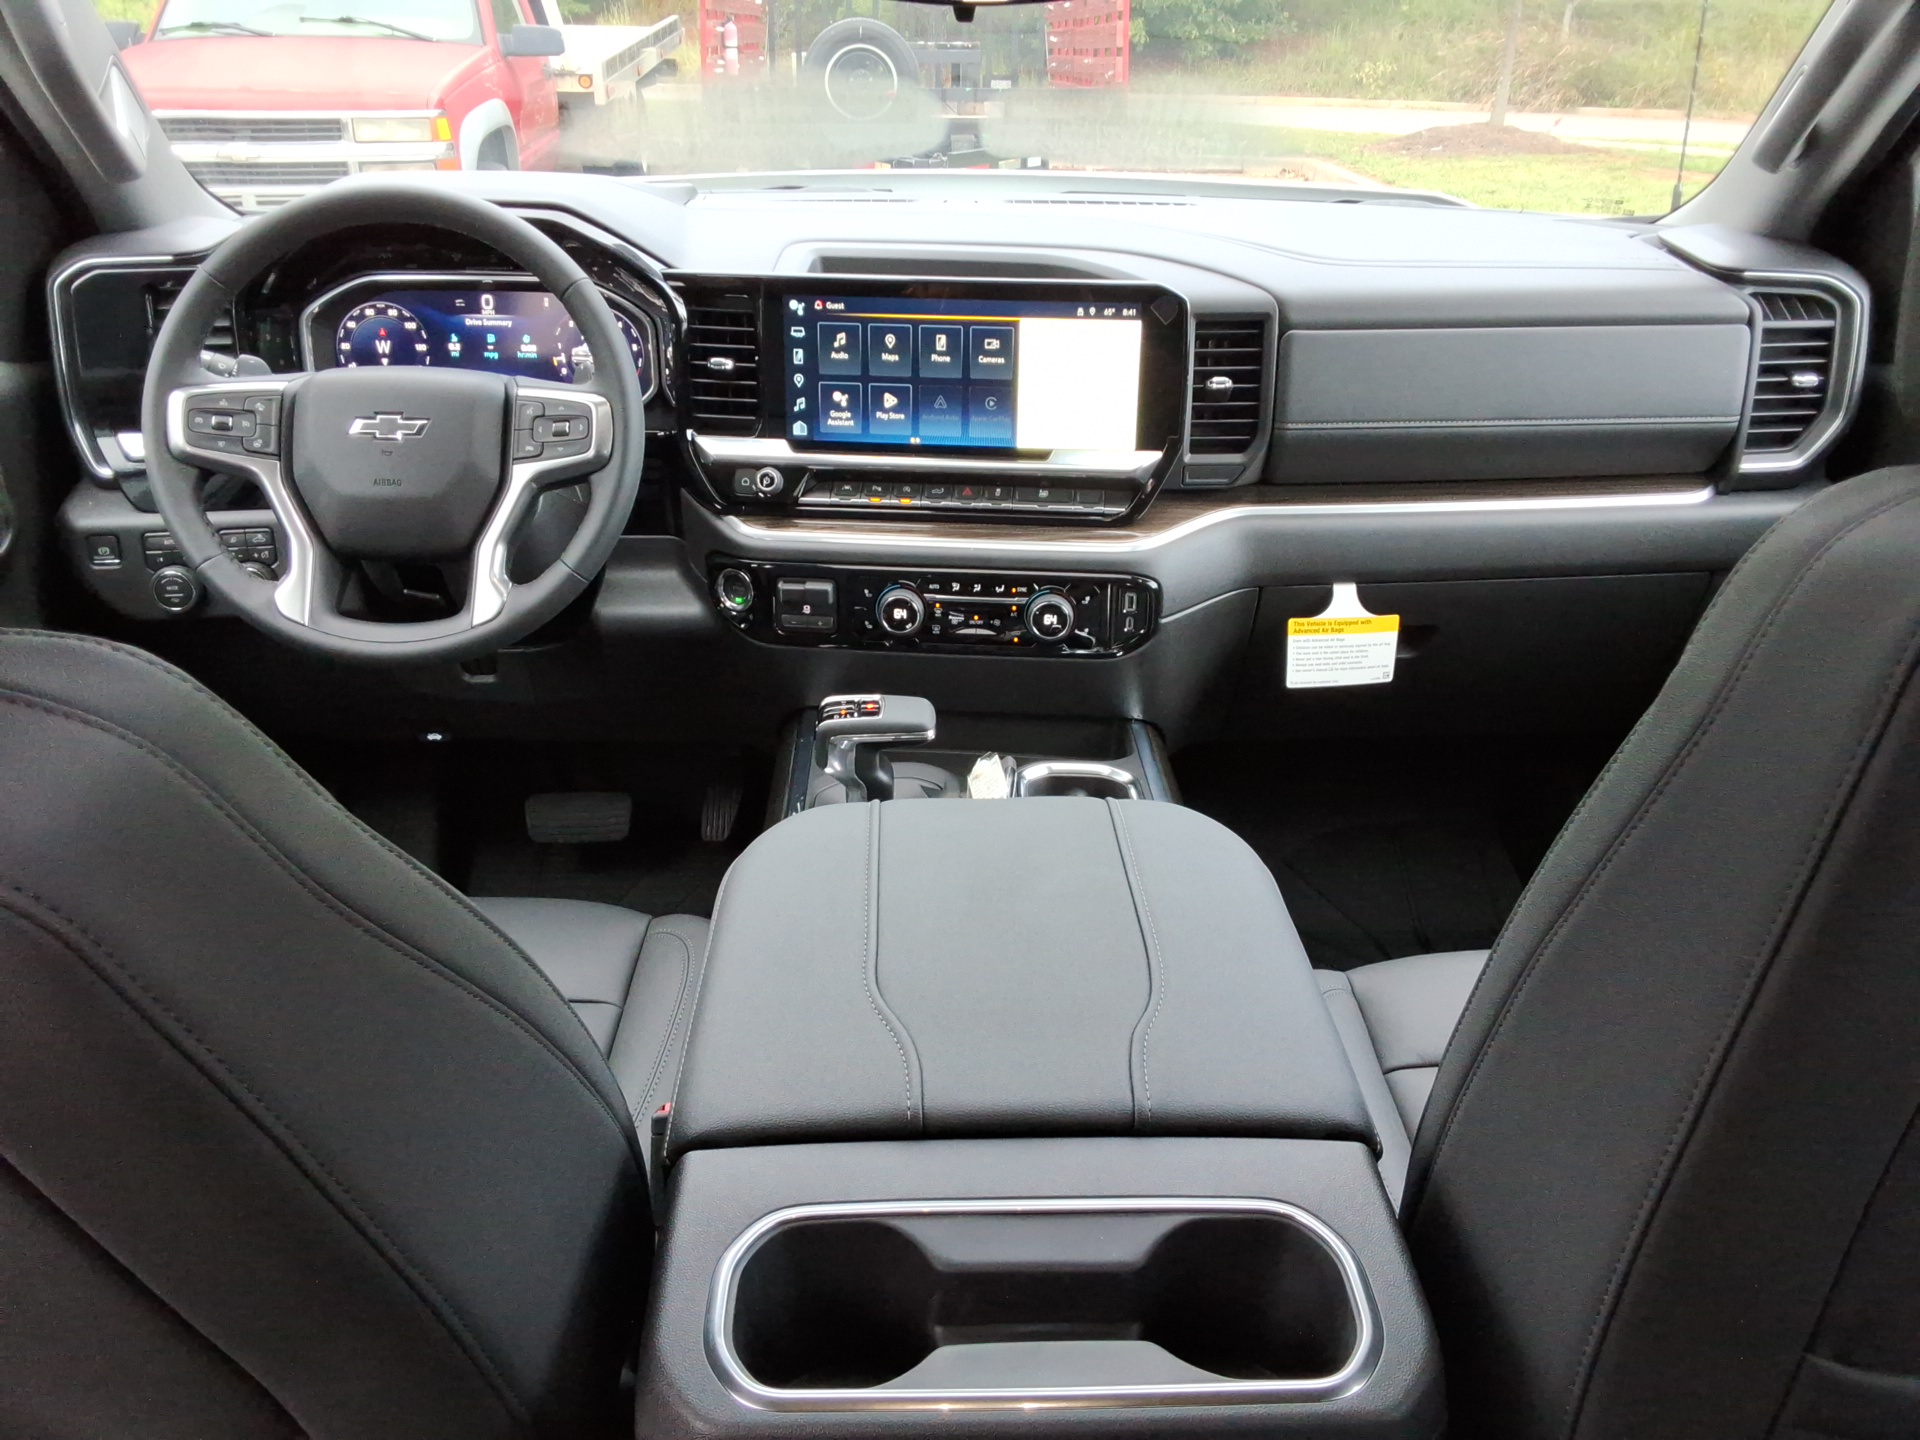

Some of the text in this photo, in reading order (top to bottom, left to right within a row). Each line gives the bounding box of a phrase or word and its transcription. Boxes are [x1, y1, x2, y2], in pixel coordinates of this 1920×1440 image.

[481, 294, 493, 309] 0
[825, 302, 845, 310] Guest
[483, 319, 512, 327] Summary
[375, 340, 391, 354] W
[484, 351, 499, 360] mpg
[831, 352, 849, 360] Audio
[882, 353, 899, 362] Maps
[931, 354, 951, 362] Phone
[978, 355, 1005, 364] Cameras
[830, 410, 852, 419] Google
[876, 411, 905, 421] Play Store
[827, 418, 854, 427] Assistant
[373, 478, 402, 487] AIRBAG
[893, 608, 907, 619] 64
[1043, 614, 1057, 625] 64
